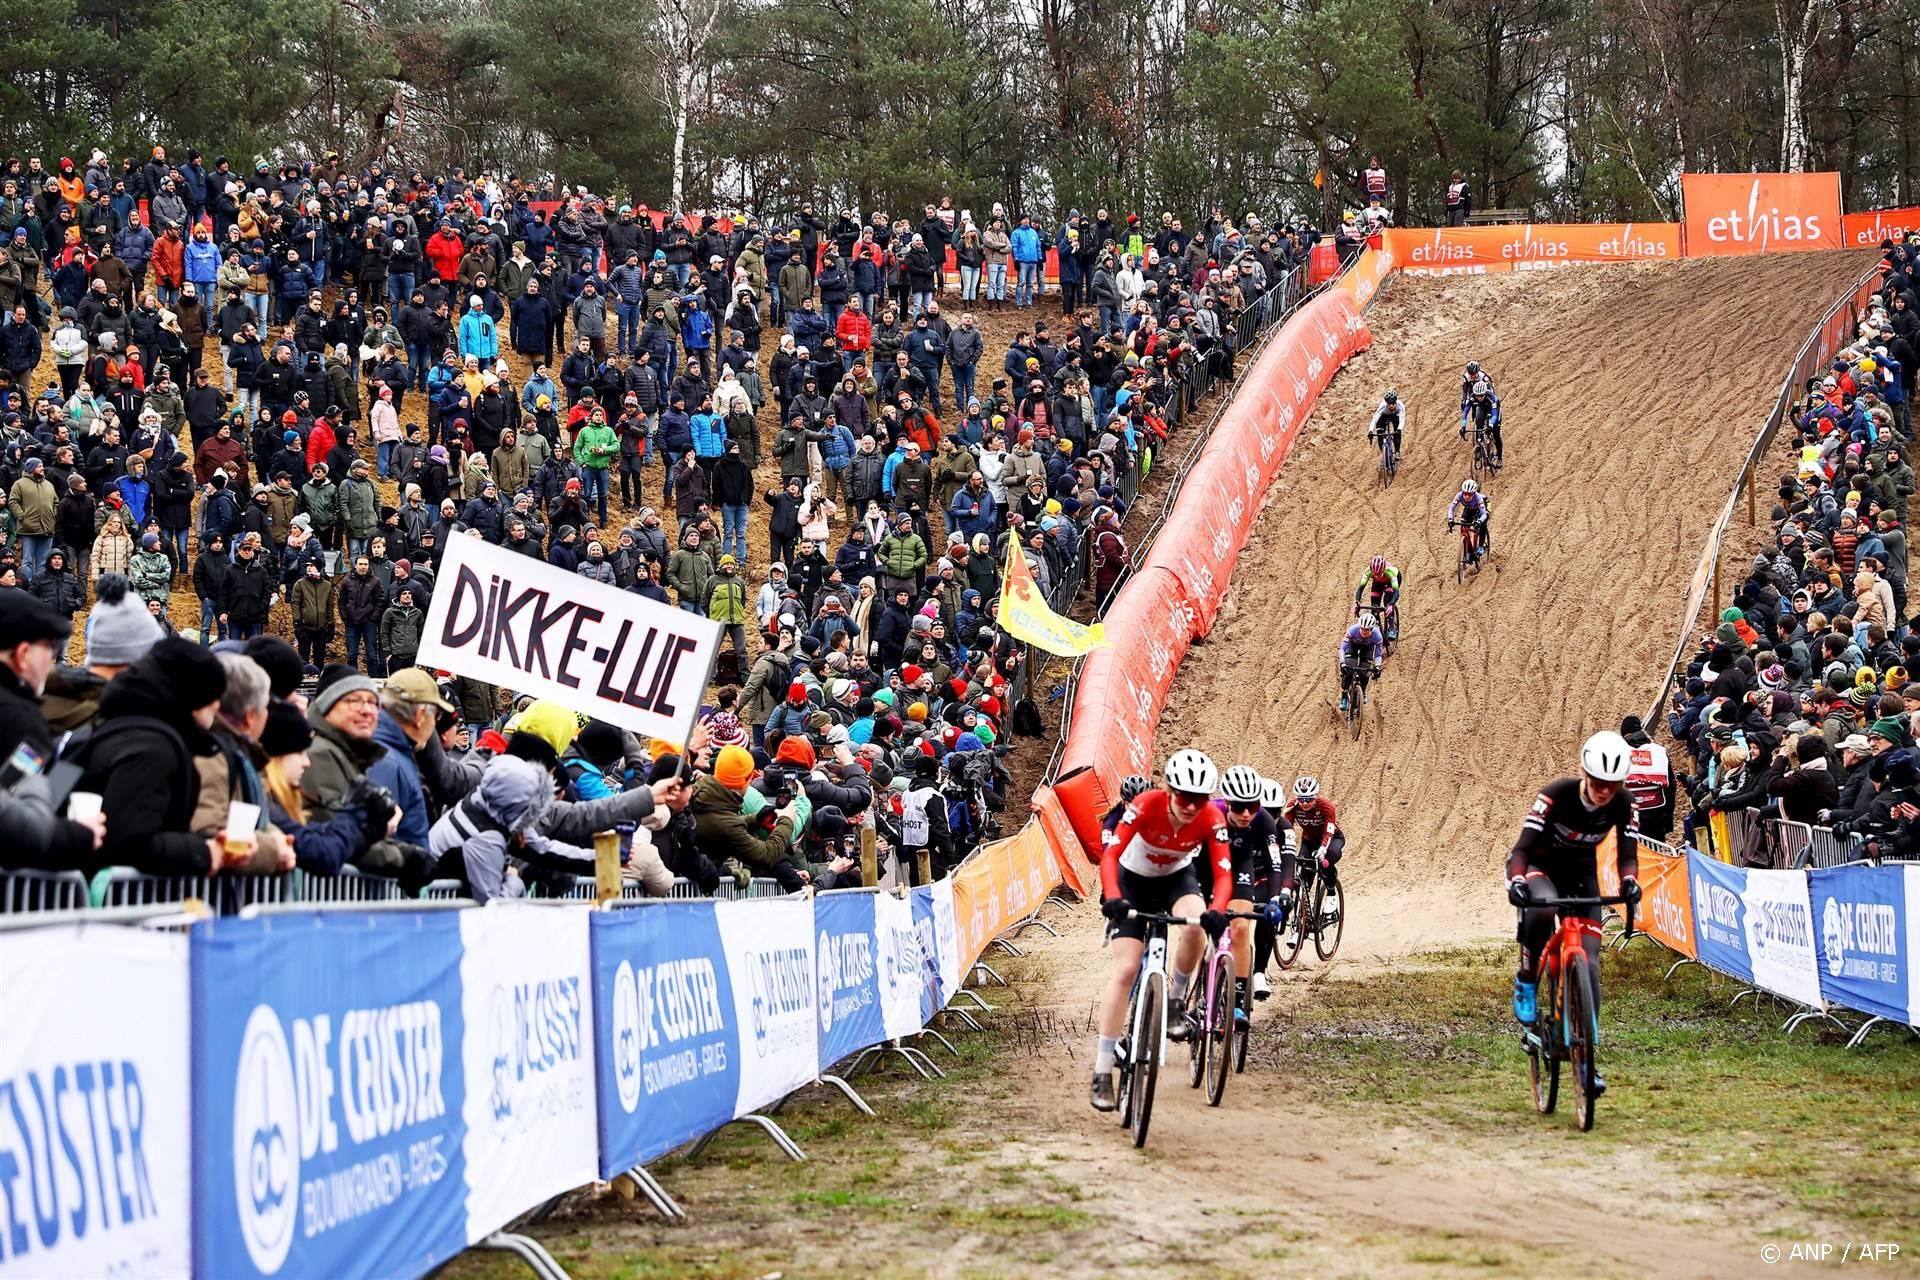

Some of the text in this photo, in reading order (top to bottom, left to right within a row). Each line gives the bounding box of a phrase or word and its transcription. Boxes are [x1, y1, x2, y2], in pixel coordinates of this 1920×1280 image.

[1412, 227, 1474, 264] ethias
[1502, 224, 1568, 262] ethias
[1600, 223, 1666, 259] ethias
[1707, 179, 1822, 254] ethias
[637, 966, 660, 1051] DE
[656, 957, 725, 1043] CEUSTER
[293, 1013, 338, 1162] DE
[339, 998, 447, 1144] CEUSTER
[0, 1060, 157, 1268] EUSTER
